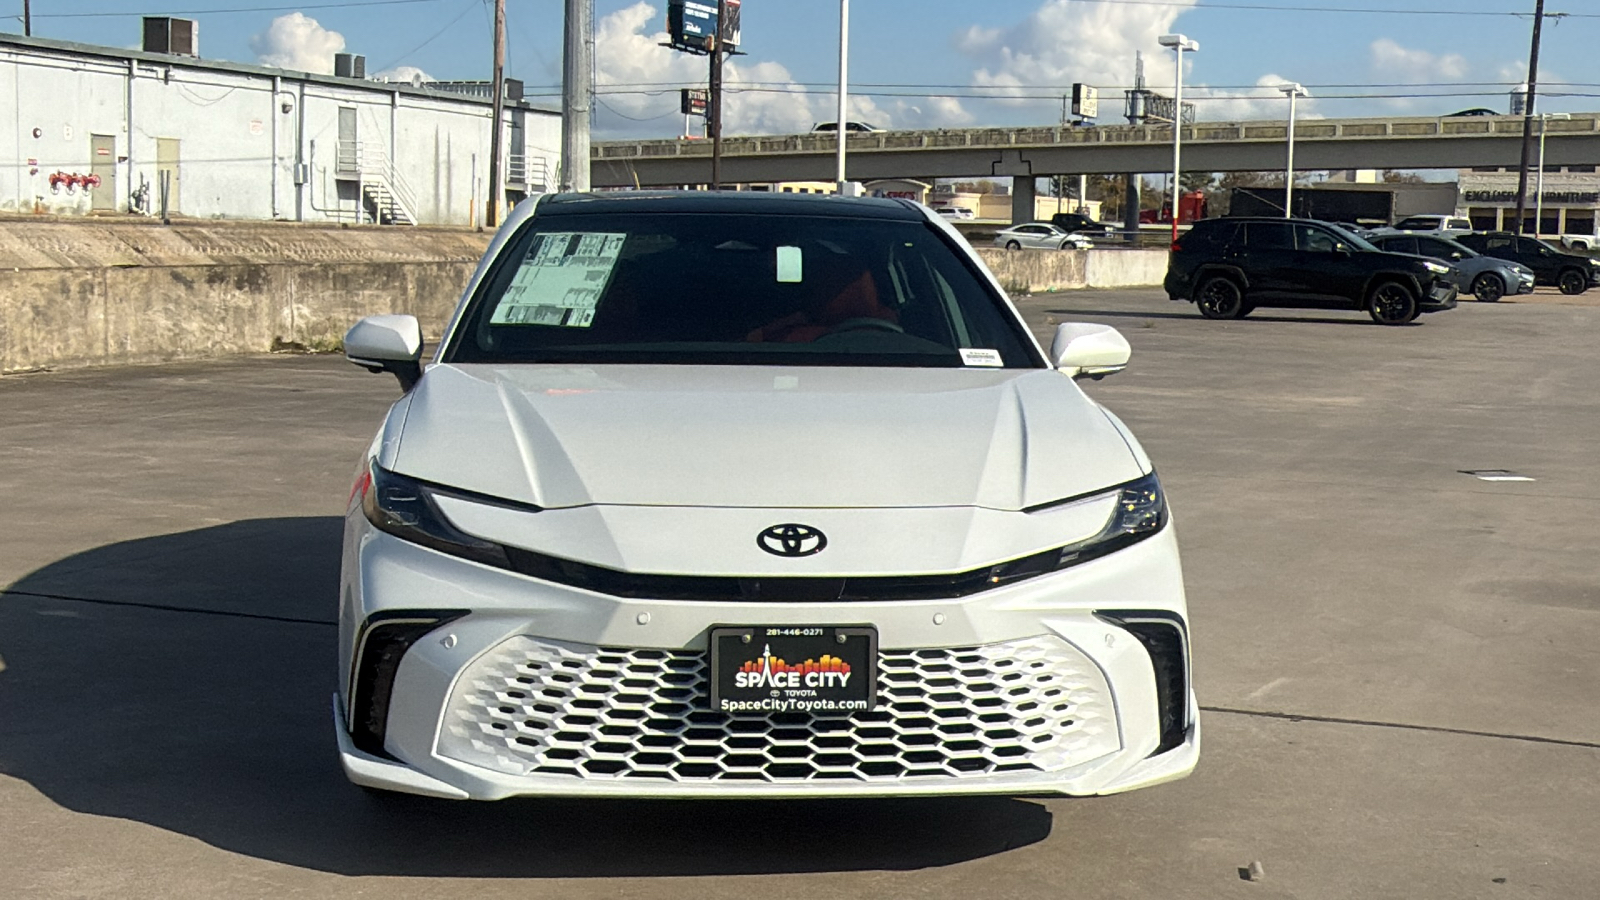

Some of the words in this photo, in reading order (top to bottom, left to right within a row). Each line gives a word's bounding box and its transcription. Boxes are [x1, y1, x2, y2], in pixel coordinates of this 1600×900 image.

[766, 628, 823, 636] 281-446-0271
[735, 671, 801, 688] SPACE
[805, 671, 851, 688] CITY
[720, 699, 867, 712] SpaceCityToyota.com
